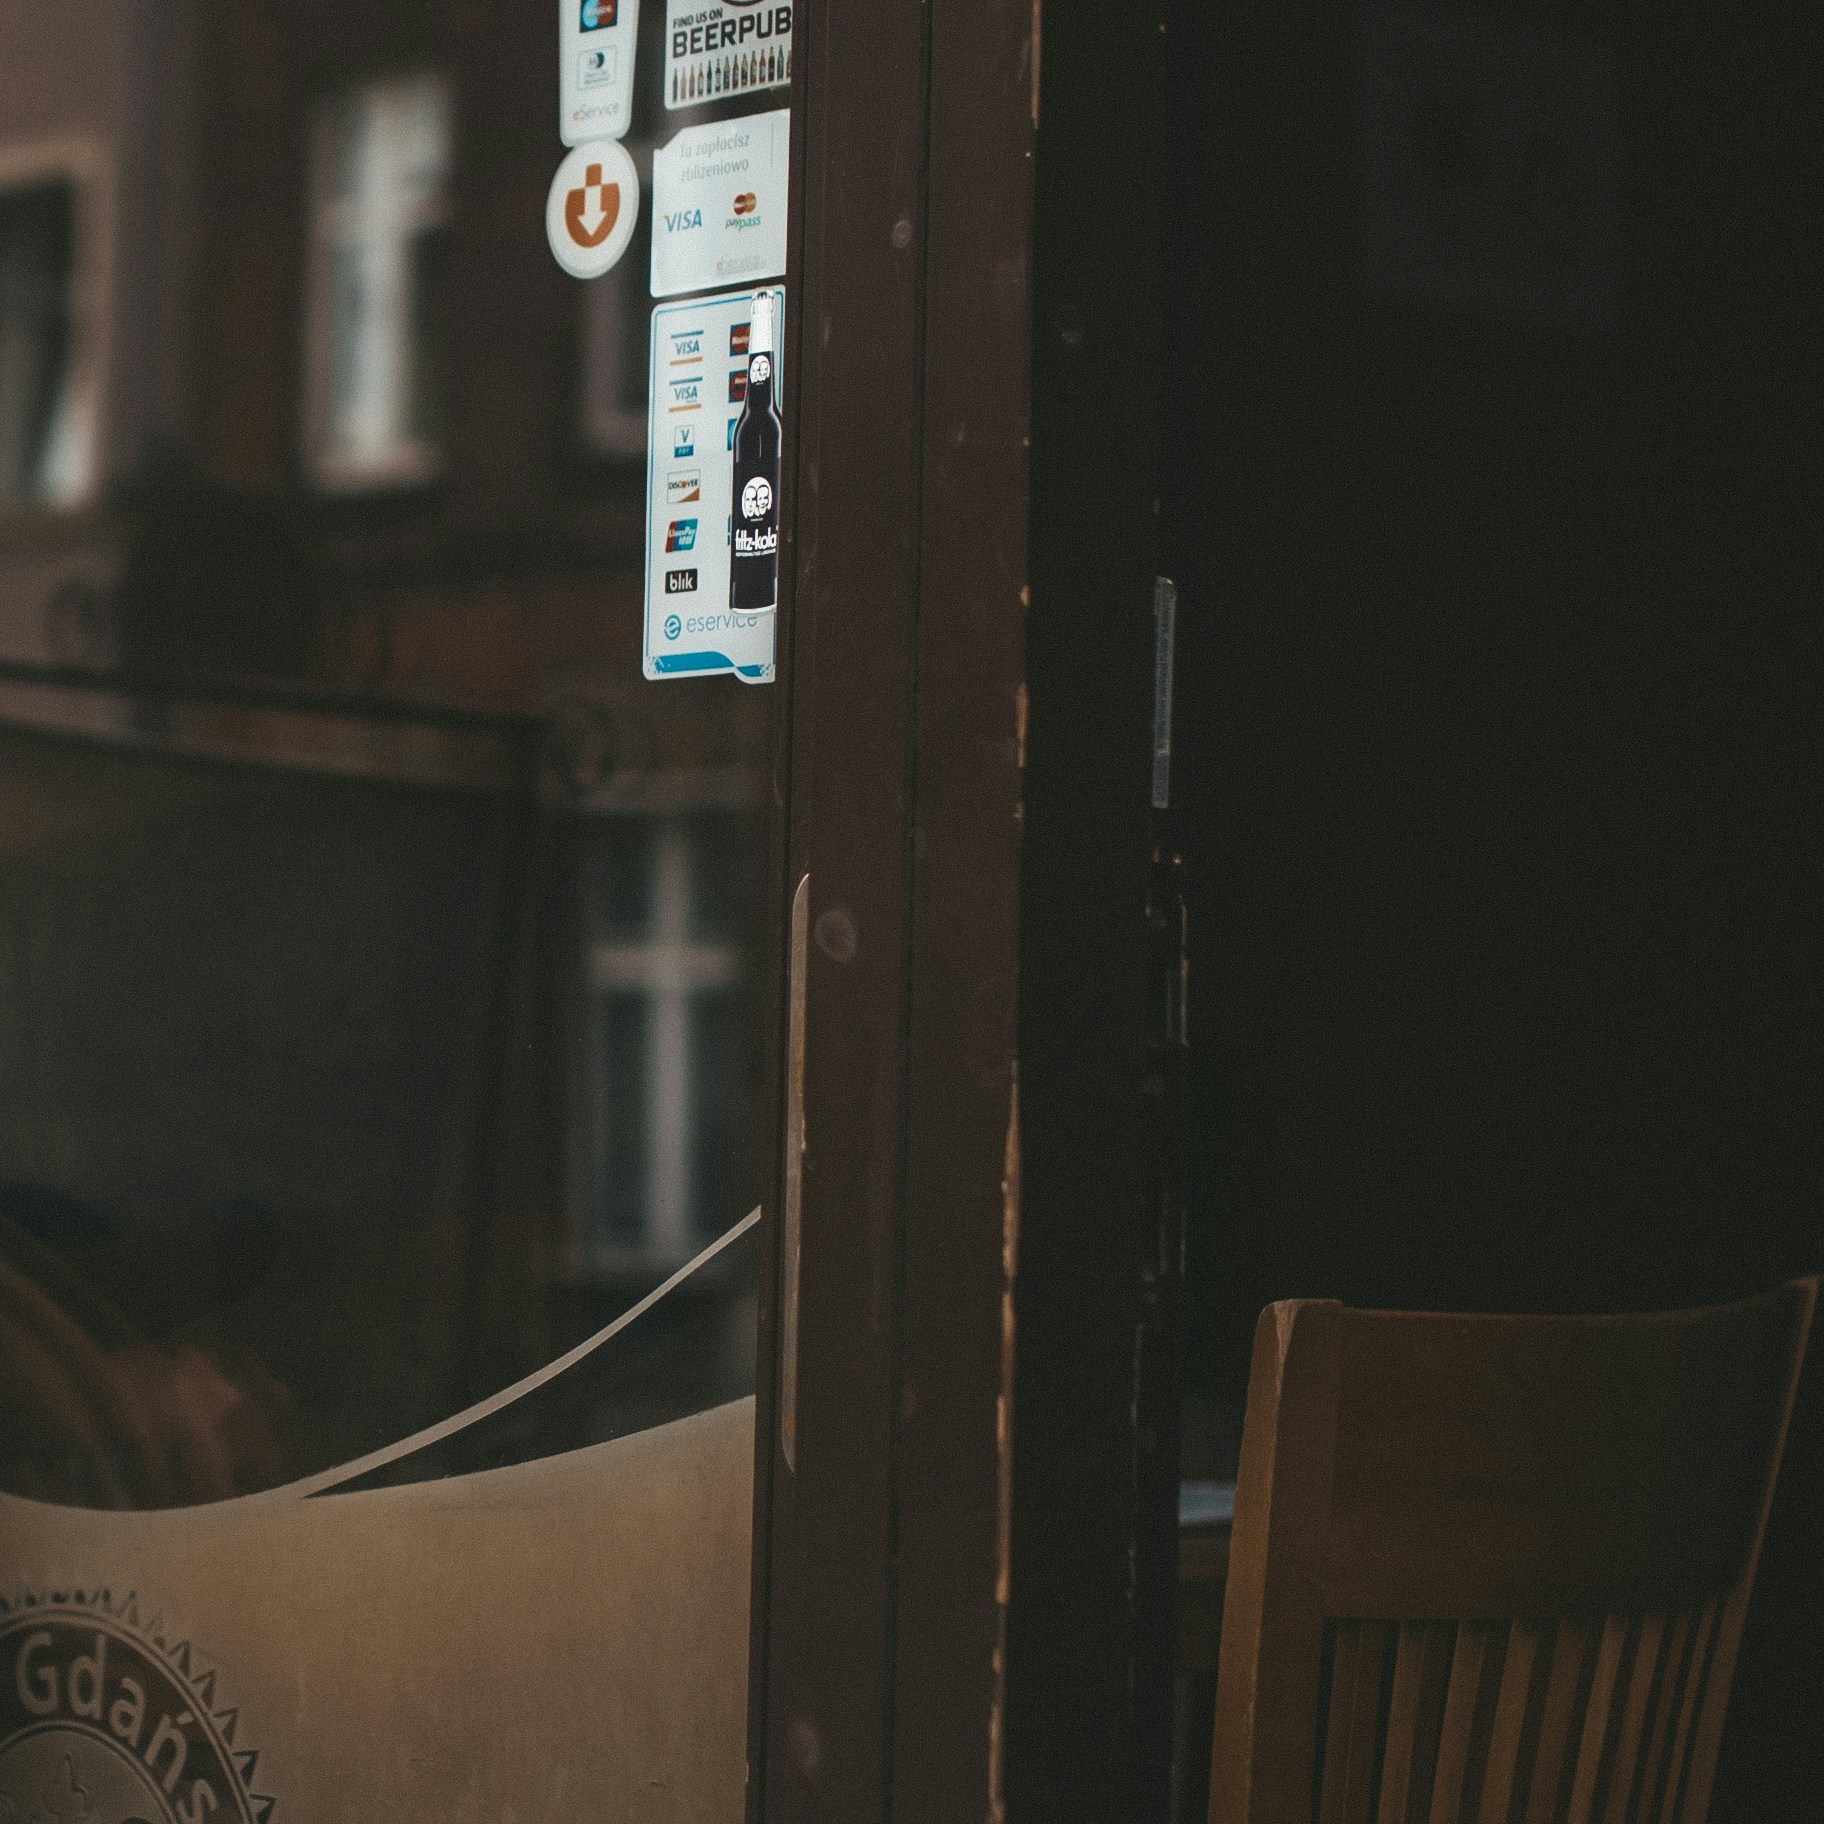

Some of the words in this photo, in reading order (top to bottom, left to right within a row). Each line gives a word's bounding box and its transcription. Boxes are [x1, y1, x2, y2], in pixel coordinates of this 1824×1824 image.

[673, 14, 694, 29] FIND
[695, 10, 707, 24] US
[709, 6, 723, 21] ON
[672, 5, 792, 58] BEERPUB
[663, 208, 703, 233] VISA
[674, 339, 700, 355] VISA
[673, 385, 698, 401] VISA
[668, 478, 698, 491] DISCOVER
[669, 571, 694, 592] blik
